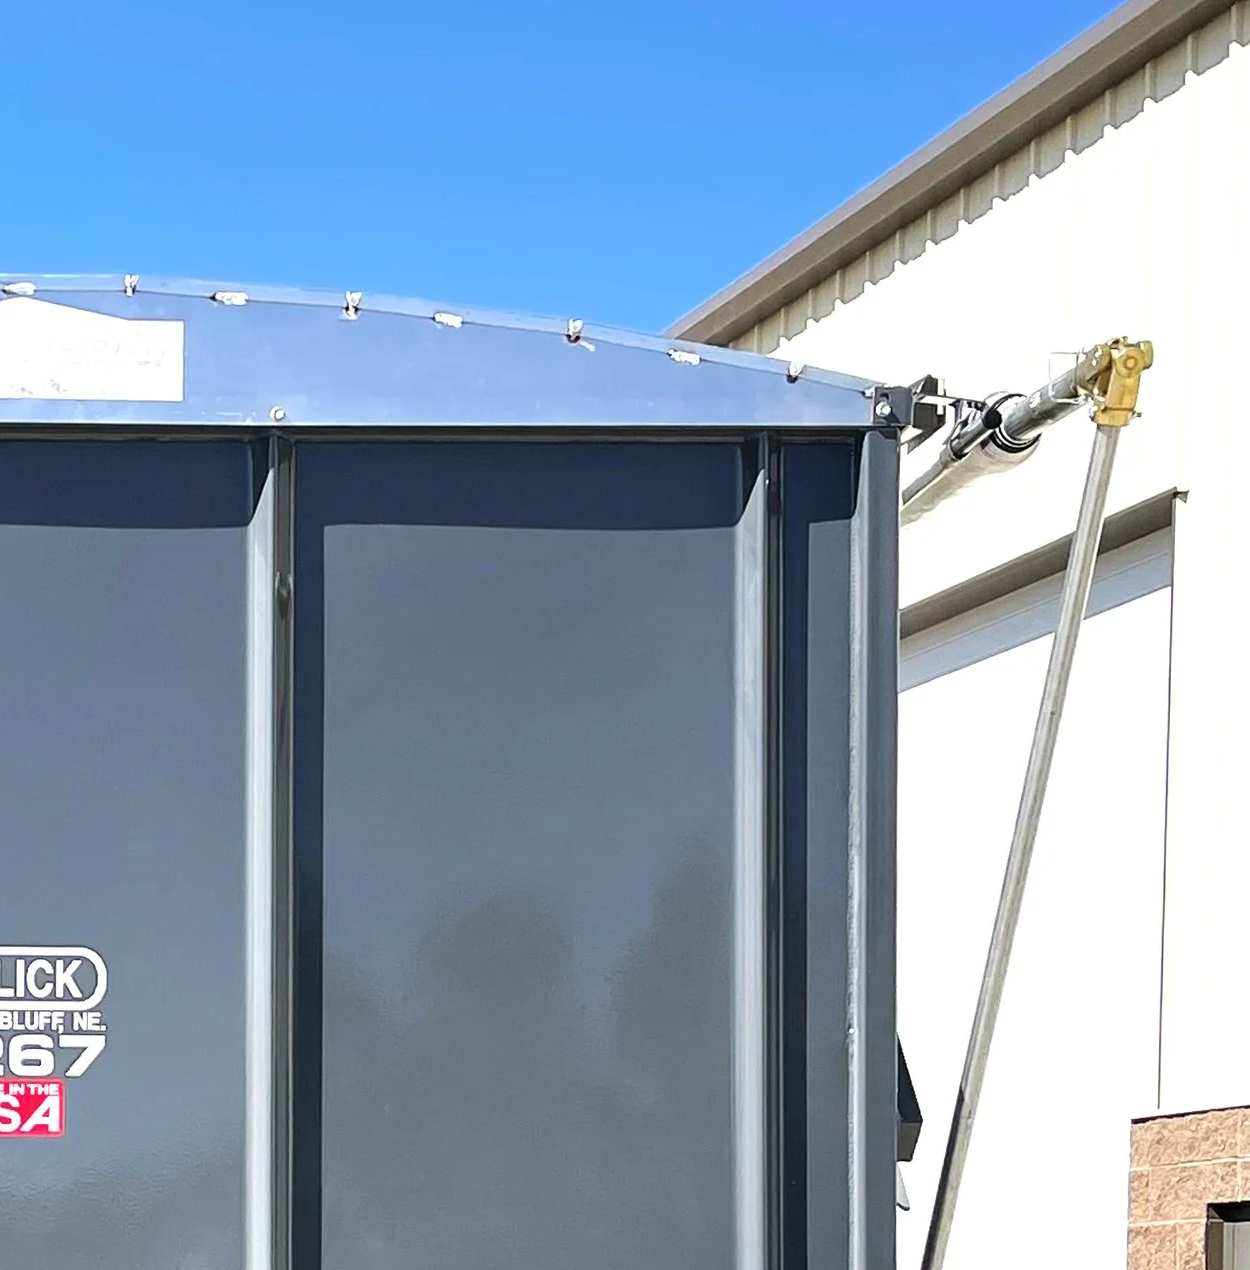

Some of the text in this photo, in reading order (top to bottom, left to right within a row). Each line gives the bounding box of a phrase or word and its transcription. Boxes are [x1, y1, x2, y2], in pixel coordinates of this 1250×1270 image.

[72, 1011, 107, 1032] NE.
[9, 1083, 25, 1096] IN
[27, 1083, 60, 1096] THE
